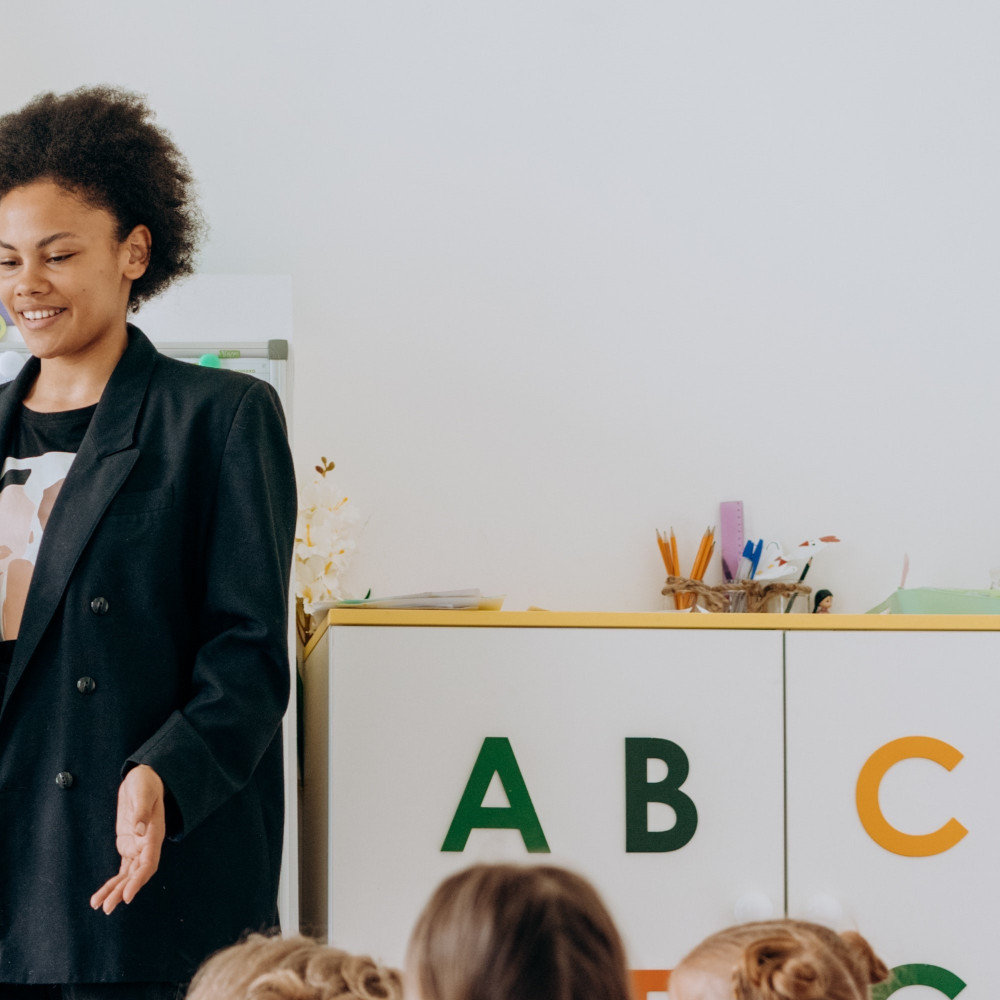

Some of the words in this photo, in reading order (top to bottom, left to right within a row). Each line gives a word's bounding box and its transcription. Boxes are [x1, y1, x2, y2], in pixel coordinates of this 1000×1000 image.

[441, 737, 550, 852] A
[625, 737, 698, 853] B
[856, 736, 969, 857] C
